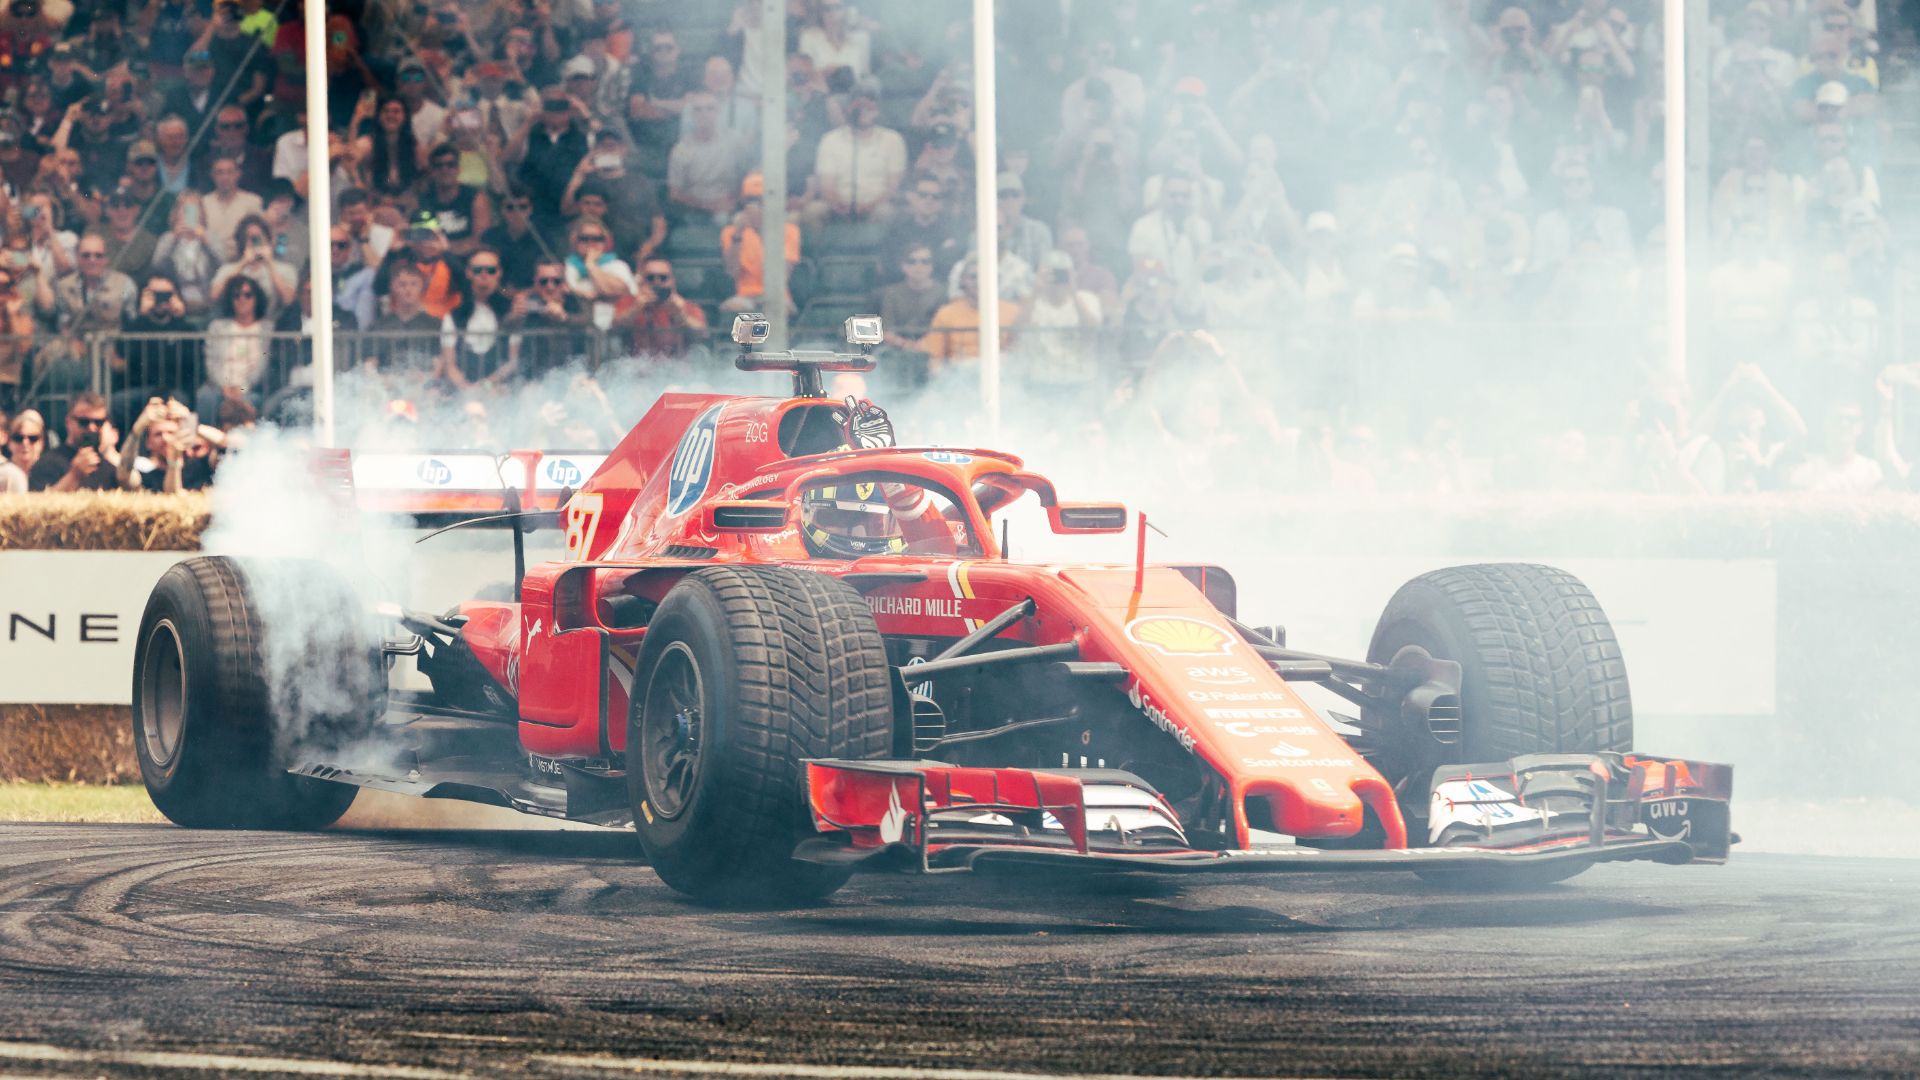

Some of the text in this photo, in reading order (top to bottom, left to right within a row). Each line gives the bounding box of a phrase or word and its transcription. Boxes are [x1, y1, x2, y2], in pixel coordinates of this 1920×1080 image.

[745, 422, 769, 443] ZCG
[420, 459, 448, 484] hp
[550, 460, 577, 485] hp
[564, 492, 604, 561] 87
[864, 595, 962, 618] RICHARD MILLE
[1142, 694, 1197, 755] Santander
[1242, 757, 1354, 768] Santander
